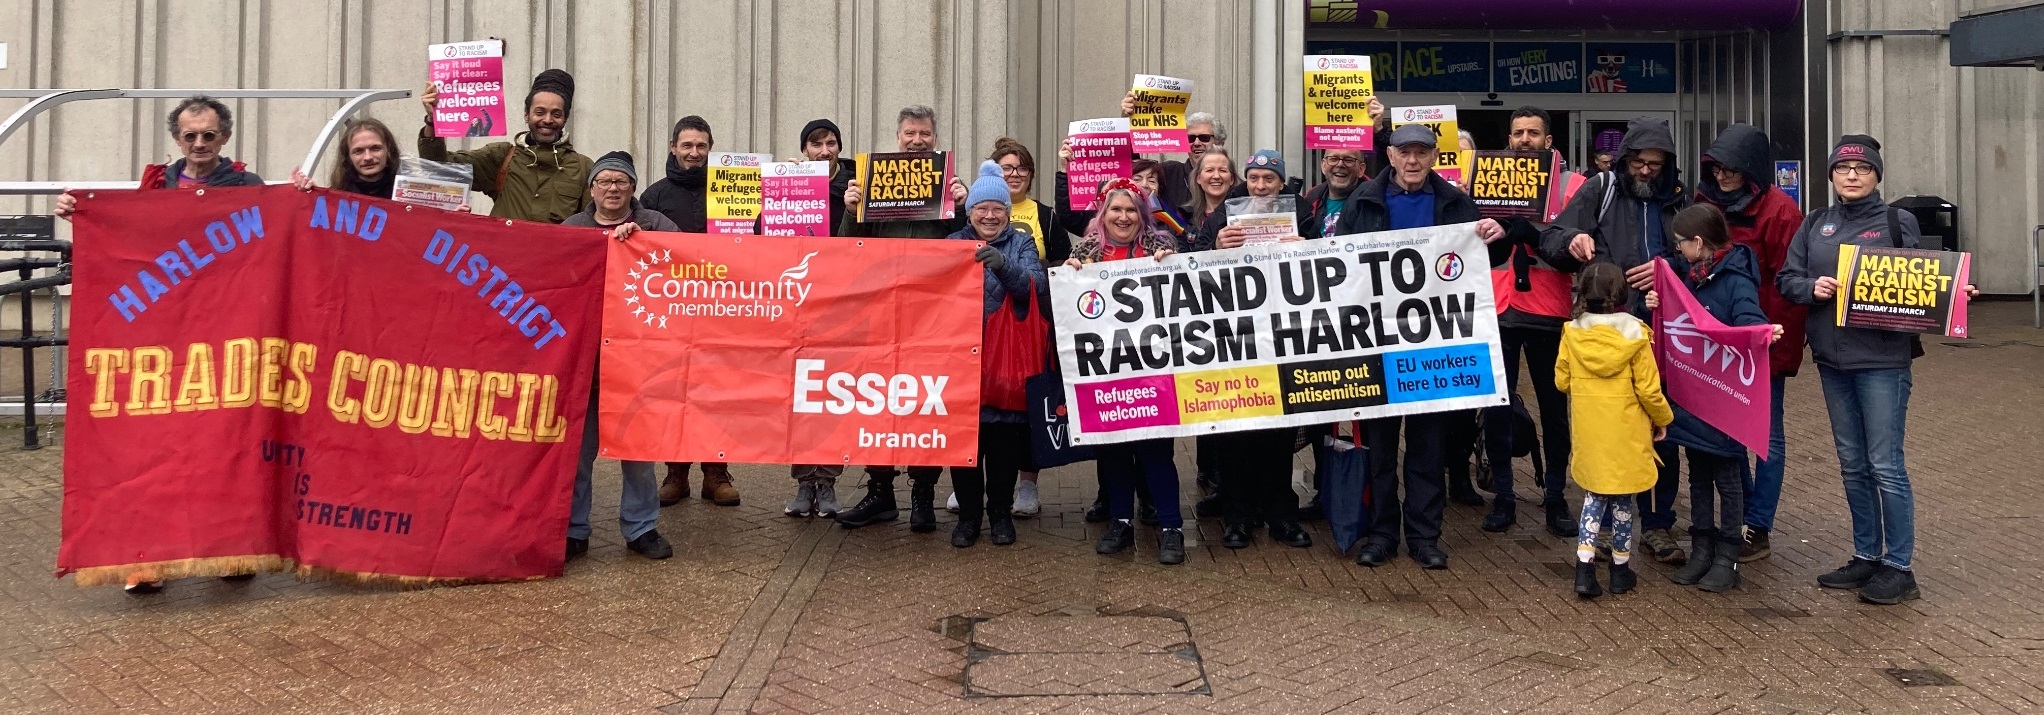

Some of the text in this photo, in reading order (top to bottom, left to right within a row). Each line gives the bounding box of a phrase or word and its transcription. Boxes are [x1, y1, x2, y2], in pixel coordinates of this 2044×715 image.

[434, 60, 481, 70] Say it loud
[1497, 49, 1548, 67] OH HOW VERY
[434, 70, 488, 80] Say it clear:
[1509, 60, 1577, 86] EXCITING!
[434, 79, 500, 95] Refugees
[1313, 74, 1364, 87] Migrants
[1134, 90, 1186, 104] Migrants
[1308, 87, 1370, 99] & refugees
[437, 94, 498, 108] welcome
[1315, 99, 1365, 109] welcome
[436, 110, 469, 122] here
[1131, 115, 1178, 126] our NHS
[1327, 112, 1353, 122] here
[1070, 137, 1127, 147] Braverman
[1134, 138, 1180, 146] scapegoating
[1332, 134, 1360, 142] migrants
[1089, 147, 1115, 157] now!
[874, 159, 933, 173] MARCH
[1070, 160, 1120, 172] Refugees
[1478, 157, 1539, 172] MARCH
[716, 170, 761, 182] Migrants
[764, 178, 809, 188] Say it loud
[871, 171, 942, 187] AGAINST
[1071, 172, 1117, 182] welcome
[1475, 171, 1548, 185] AGAINST
[710, 182, 761, 195] & refugee
[764, 188, 779, 197] Say
[782, 188, 788, 196] it
[870, 185, 932, 200] RACISM
[1072, 185, 1096, 194] here
[1474, 184, 1537, 198] RACISM
[402, 190, 435, 200] Socialist
[436, 192, 463, 203] Worker
[716, 195, 761, 204] welcome
[728, 206, 752, 216] here
[764, 197, 826, 212] Refugees
[764, 212, 823, 225] welcome
[764, 226, 795, 236] here
[1241, 225, 1292, 234] ocialist Worker
[1254, 253, 1271, 262] Stand
[1273, 253, 1282, 262] Up
[1293, 250, 1316, 258] Racism
[1317, 246, 1340, 255] Harlow
[670, 259, 728, 280] unite
[1861, 254, 1940, 275] MARCH
[109, 195, 566, 350] HARLOW AND DISTRICT
[1111, 248, 1426, 322] STAND UP TO
[1855, 270, 1952, 292] AGAINST
[644, 273, 812, 308] Community
[1854, 285, 1936, 308] RACISM
[668, 300, 783, 322] membership
[1852, 304, 1888, 313] SATURDAY
[1898, 307, 1925, 316] MARCH
[1074, 292, 1475, 377] RACISM HARLOW
[1396, 354, 1476, 374] EU workers
[1294, 364, 1369, 385] Stamp out
[1666, 351, 1750, 405] The communications union
[85, 336, 567, 442] TRADES COUNCIL
[793, 358, 950, 416] Essex
[1195, 376, 1259, 395] Say no to
[1397, 373, 1481, 392] here to stay
[1095, 386, 1157, 405] Refugees
[1288, 383, 1380, 405] antisemitism
[1184, 393, 1276, 414] Islamophobia
[1099, 405, 1158, 423] welcome
[858, 428, 947, 449] branch
[293, 472, 311, 495] IS
[297, 498, 412, 534] STRENGTH
